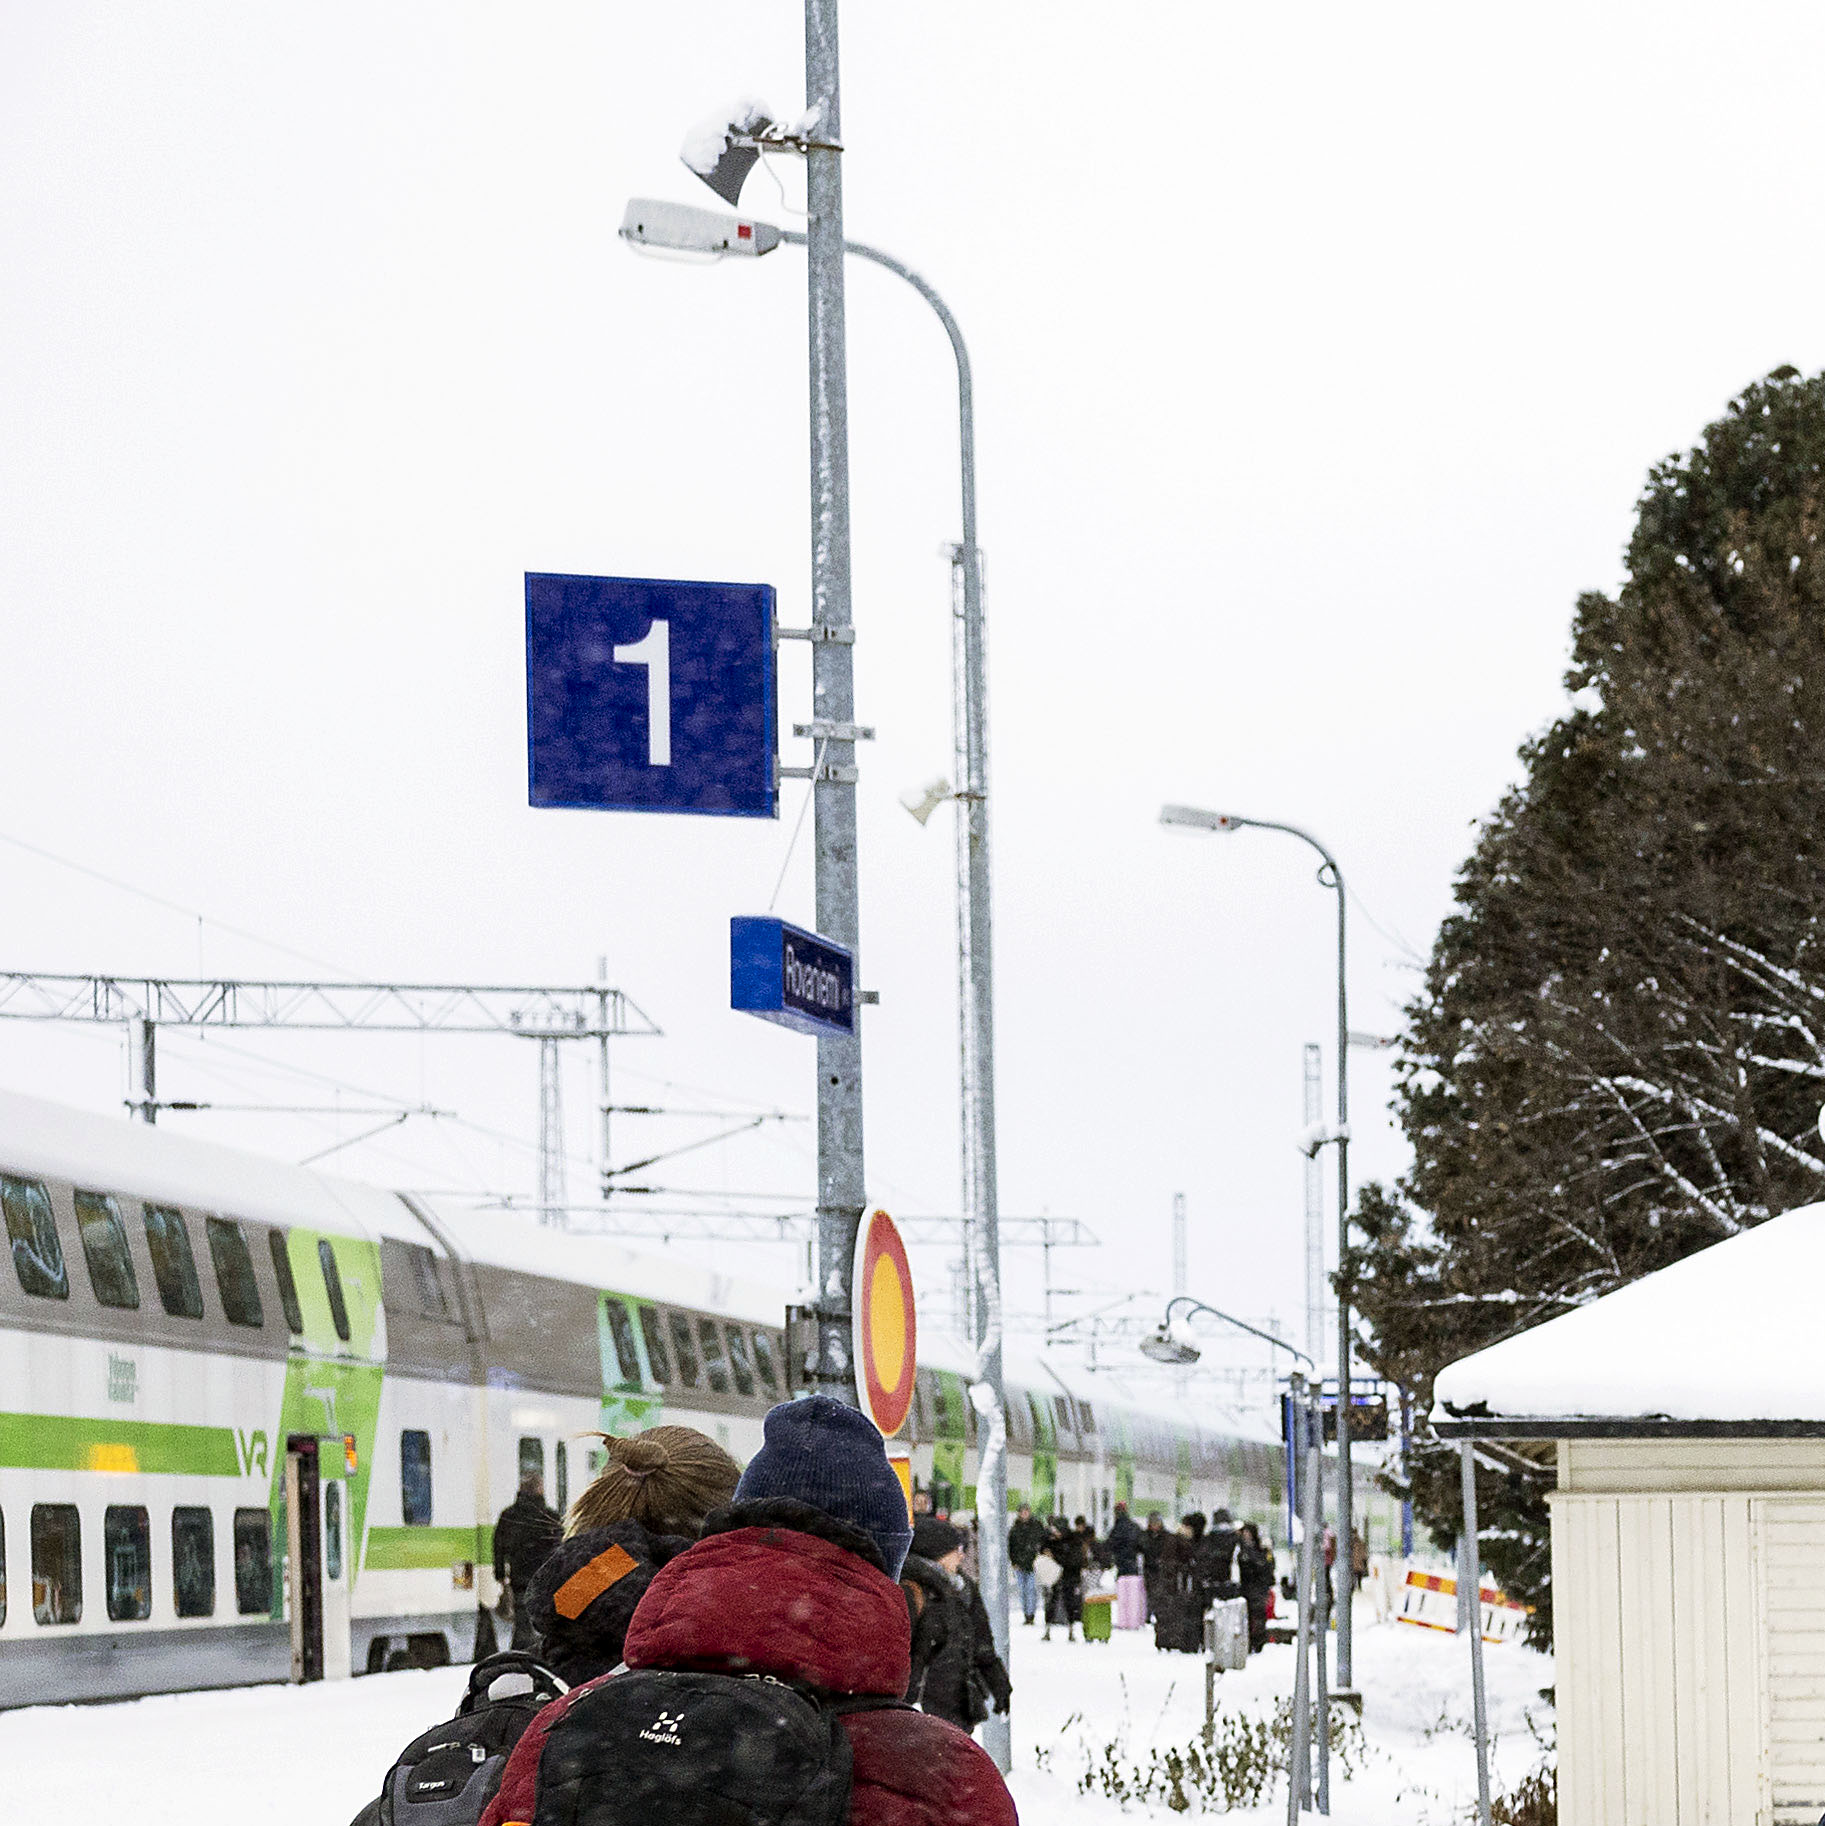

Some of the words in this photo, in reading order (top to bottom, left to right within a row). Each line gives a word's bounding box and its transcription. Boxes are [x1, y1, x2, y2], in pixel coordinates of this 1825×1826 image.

[612, 618, 671, 767] 1
[232, 1427, 268, 1478] VR
[639, 1729, 682, 1746] Haglöfs
